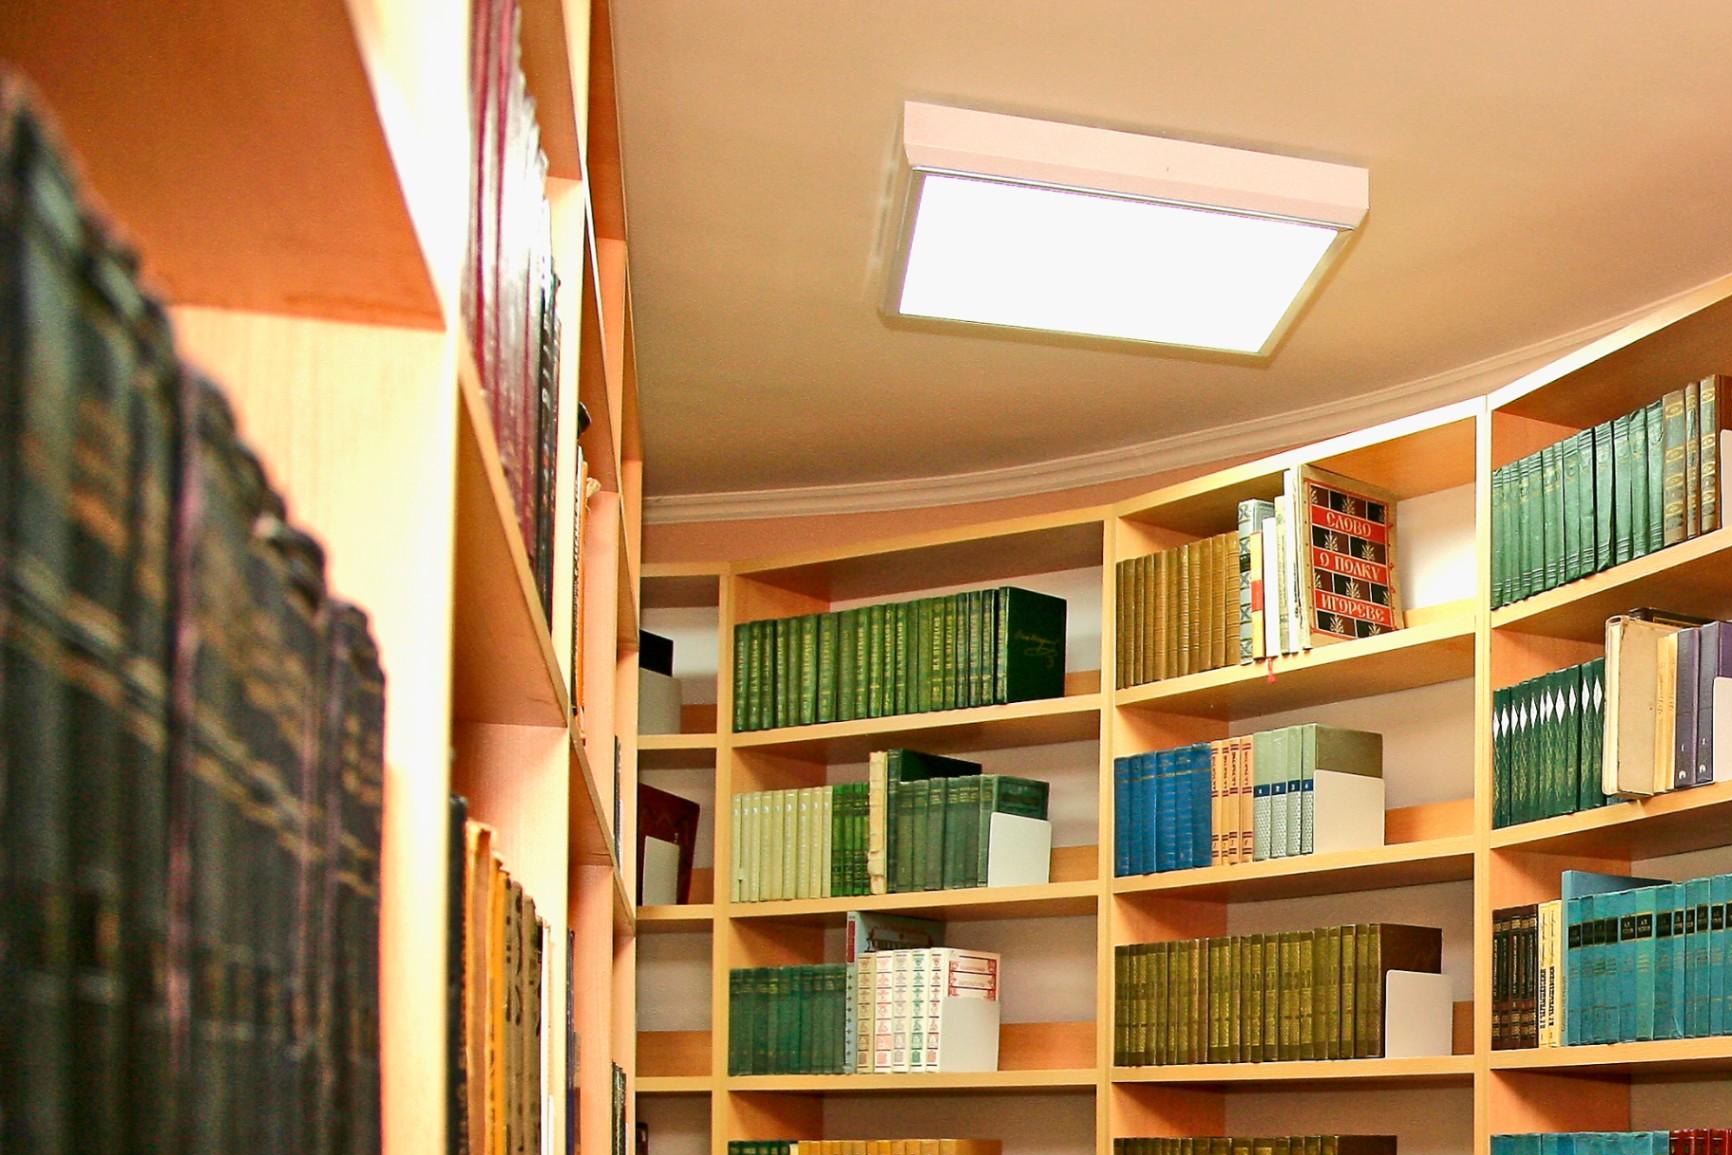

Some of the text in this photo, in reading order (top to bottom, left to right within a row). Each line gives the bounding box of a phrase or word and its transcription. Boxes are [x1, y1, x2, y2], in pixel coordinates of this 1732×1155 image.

[1326, 512, 1372, 537] СЛОВО
[1320, 552, 1381, 581] О ПОЛКУ
[1321, 593, 1385, 622] ИГОРЕВЕ
